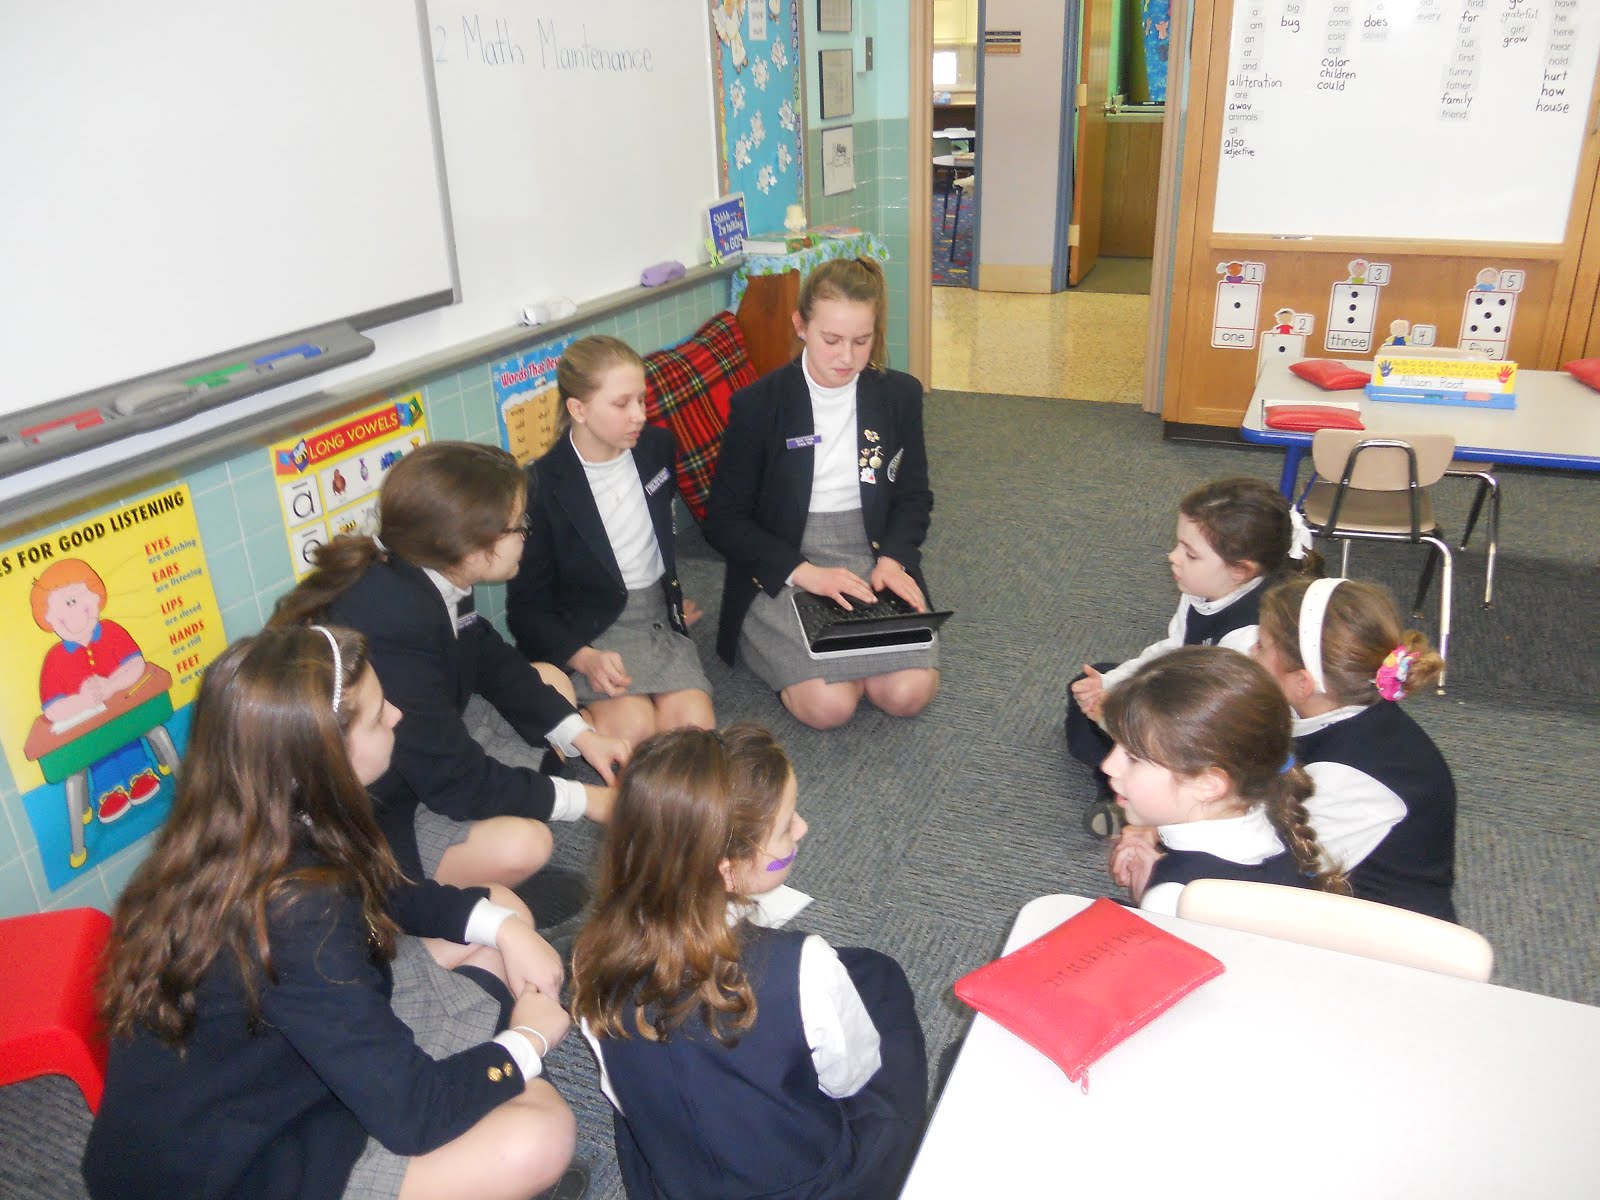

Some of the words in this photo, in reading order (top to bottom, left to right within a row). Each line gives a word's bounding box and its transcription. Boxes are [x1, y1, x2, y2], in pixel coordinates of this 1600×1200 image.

[1288, 4, 1300, 14] big
[1500, 8, 1538, 22] grateful
[1364, 15, 1388, 28] does
[1462, 10, 1478, 22] for
[1554, 13, 1566, 22] he
[1250, 22, 1262, 30] am
[1281, 16, 1300, 33] bug
[1511, 26, 1524, 35] girl
[1328, 32, 1346, 40] cold
[1553, 28, 1574, 36] here
[434, 25, 448, 63] 2
[462, 14, 525, 66] Math
[537, 17, 653, 72] Maintenance
[1245, 36, 1254, 44] an
[1504, 36, 1528, 48] grow
[1244, 49, 1252, 57] at
[1458, 52, 1474, 62] first
[1242, 62, 1257, 70] and
[1322, 58, 1350, 68] color
[1320, 68, 1356, 79] children
[1449, 68, 1472, 77] funny
[1544, 69, 1568, 81] hurt
[1229, 73, 1282, 88] alliteration
[1317, 80, 1346, 91] could
[1446, 81, 1471, 90] father
[1541, 84, 1565, 96] how
[1441, 92, 1472, 108] family
[1229, 102, 1252, 111] away
[1536, 100, 1570, 114] house
[1442, 110, 1466, 118] friend
[1224, 138, 1244, 148] also
[1224, 148, 1255, 158] adjective
[1251, 267, 1256, 280] 1
[1374, 268, 1382, 281] 3
[1507, 275, 1515, 288] 5
[1299, 318, 1306, 330] 2
[1222, 332, 1245, 342] one
[1330, 334, 1366, 348] three
[1419, 331, 1426, 342] 4
[1468, 342, 1494, 356] five
[501, 366, 528, 388] Words
[528, 362, 546, 377] That
[309, 434, 344, 460] LONG
[346, 412, 398, 442] VOWELS
[17, 542, 54, 568] FOR
[58, 522, 106, 553] GOOD
[109, 491, 184, 533] LISTENING
[144, 536, 171, 556] EYES
[148, 554, 161, 564] are
[163, 539, 196, 558] watching
[152, 562, 179, 583] EARS
[156, 583, 169, 593] are
[170, 568, 202, 586] listening
[160, 596, 183, 616] LIPS
[165, 616, 178, 626] are
[180, 602, 202, 618] closed
[169, 620, 204, 646] HANDS
[173, 646, 185, 656] are
[187, 635, 202, 648] still
[176, 654, 199, 674] FEET
[181, 674, 192, 684] are
